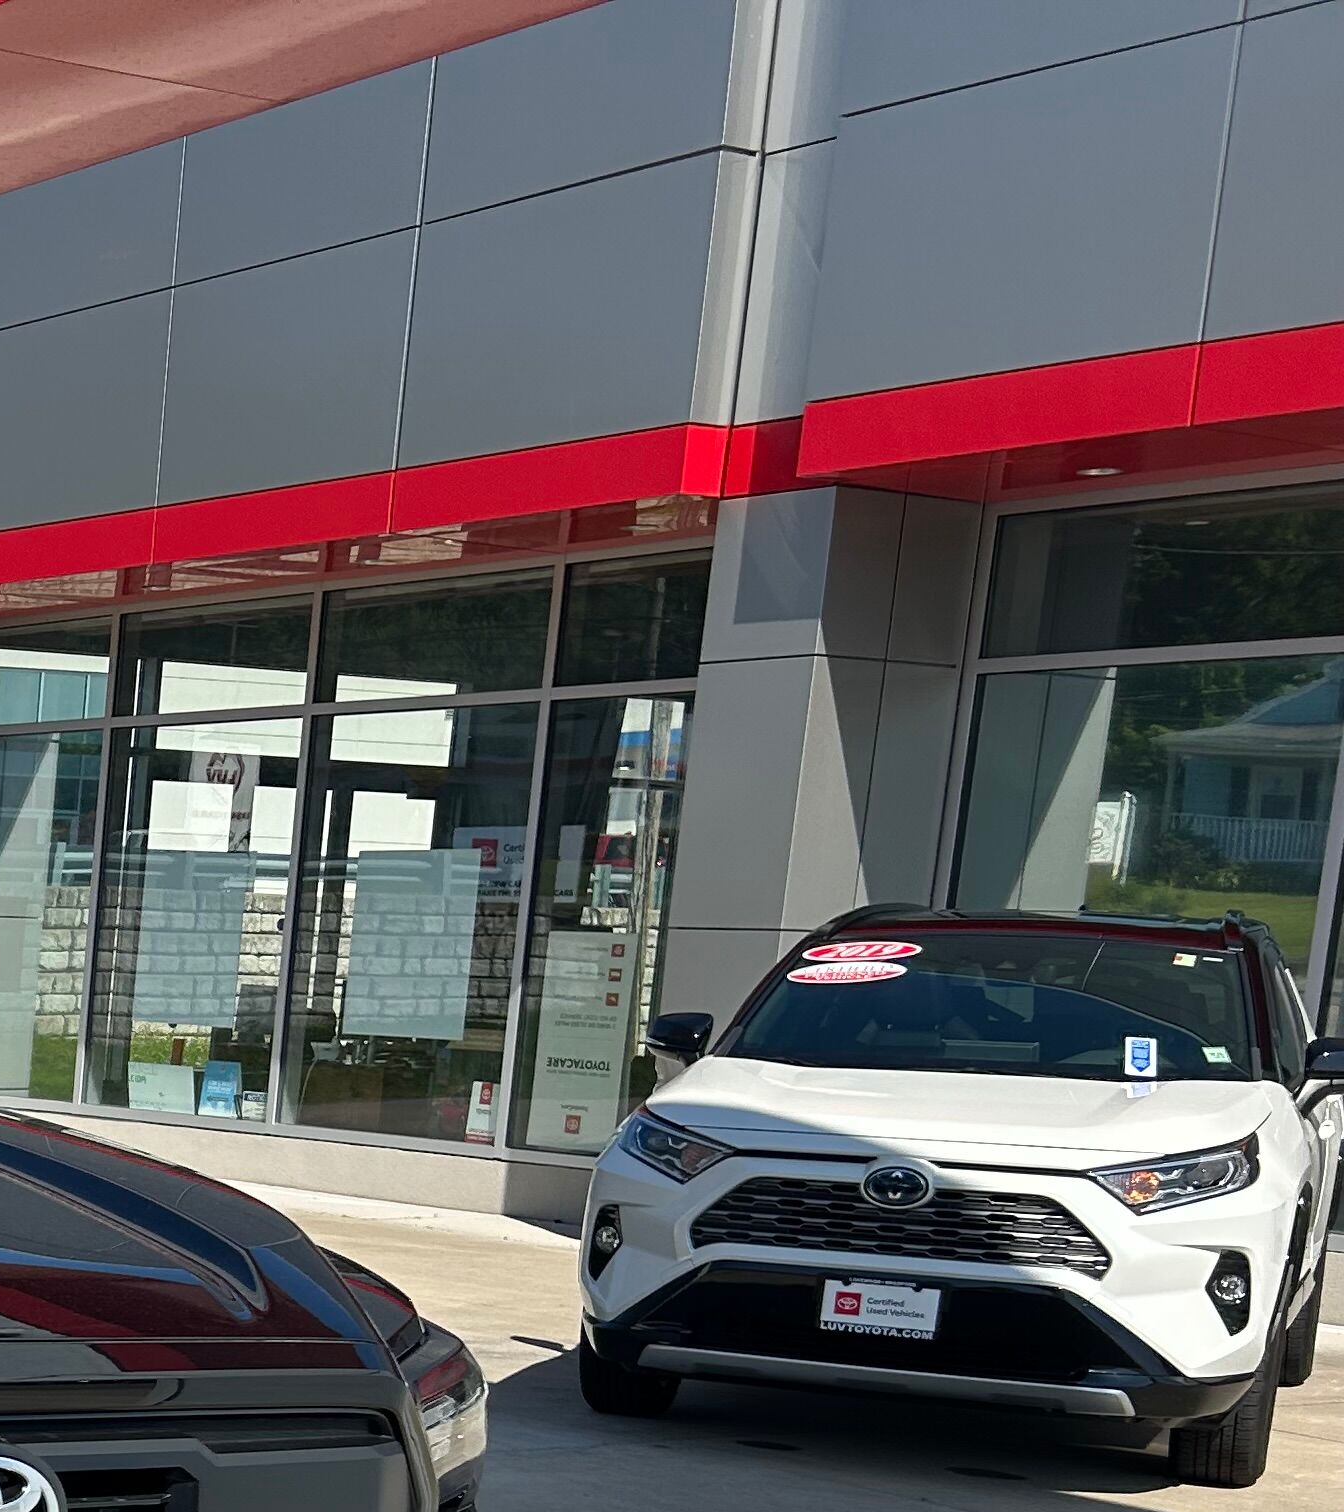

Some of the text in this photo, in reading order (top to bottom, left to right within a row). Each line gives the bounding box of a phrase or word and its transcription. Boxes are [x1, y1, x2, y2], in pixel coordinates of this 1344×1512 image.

[818, 942, 906, 958] 2019
[546, 1056, 611, 1072] TOYOTACARE
[866, 1297, 905, 1307] Certified
[866, 1307, 925, 1319] Used Vehicles
[819, 1321, 934, 1340] LUVTOYOTA.COM
